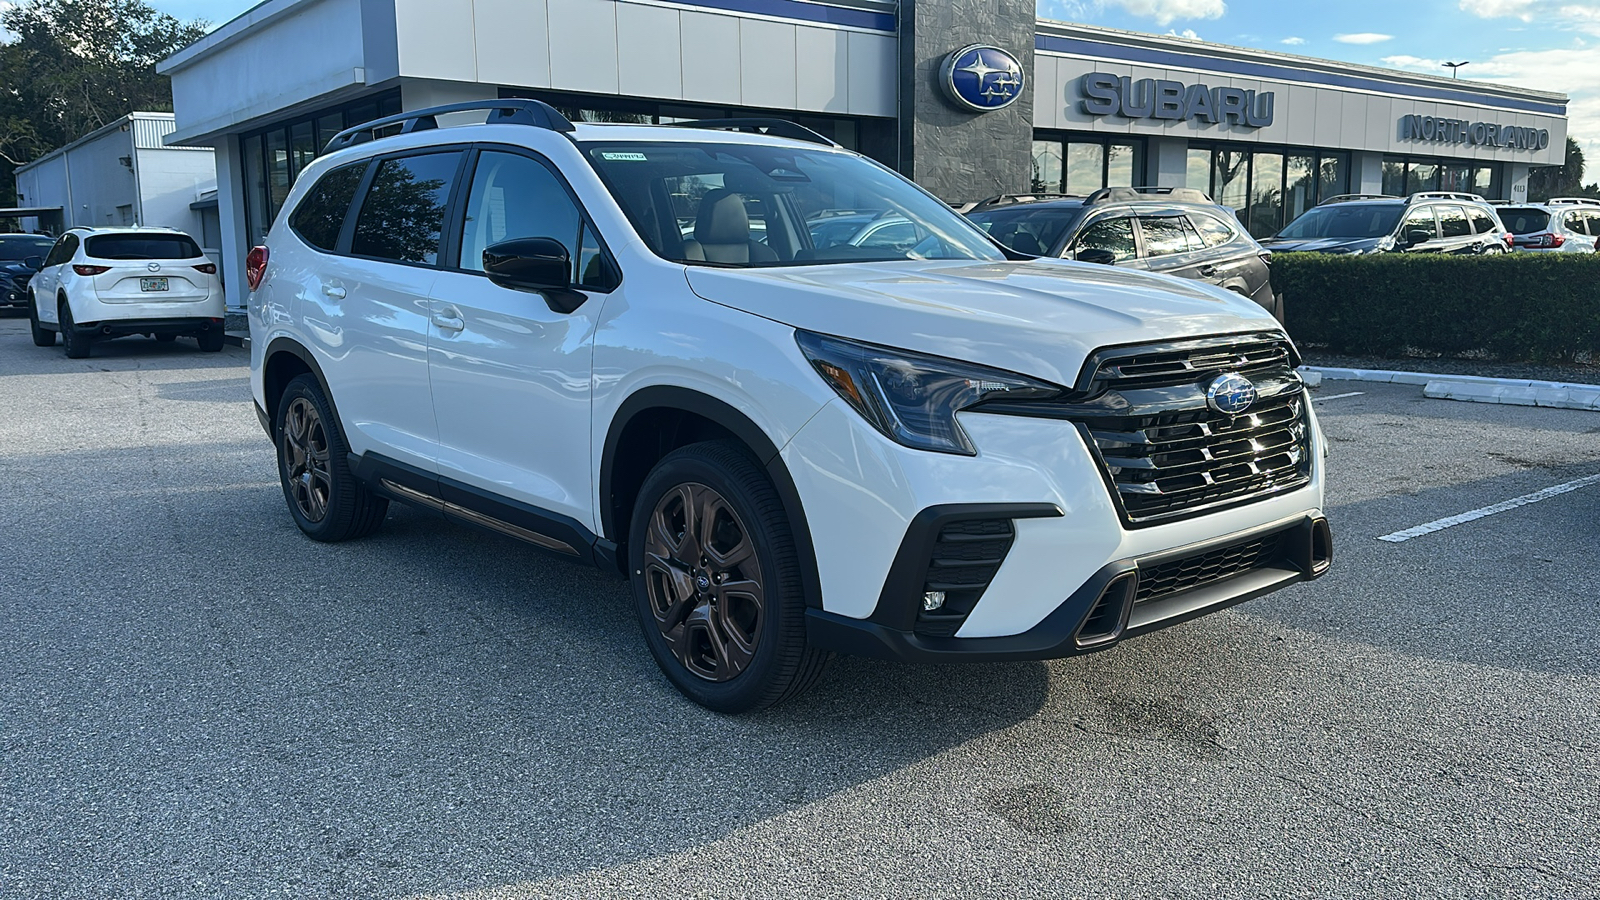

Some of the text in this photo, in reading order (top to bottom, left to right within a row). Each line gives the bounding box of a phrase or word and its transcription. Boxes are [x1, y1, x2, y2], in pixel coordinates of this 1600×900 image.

[1082, 71, 1274, 127] SUBARU
[1405, 114, 1549, 150] NORTH ORLANDO
[1513, 185, 1525, 193] 4113
